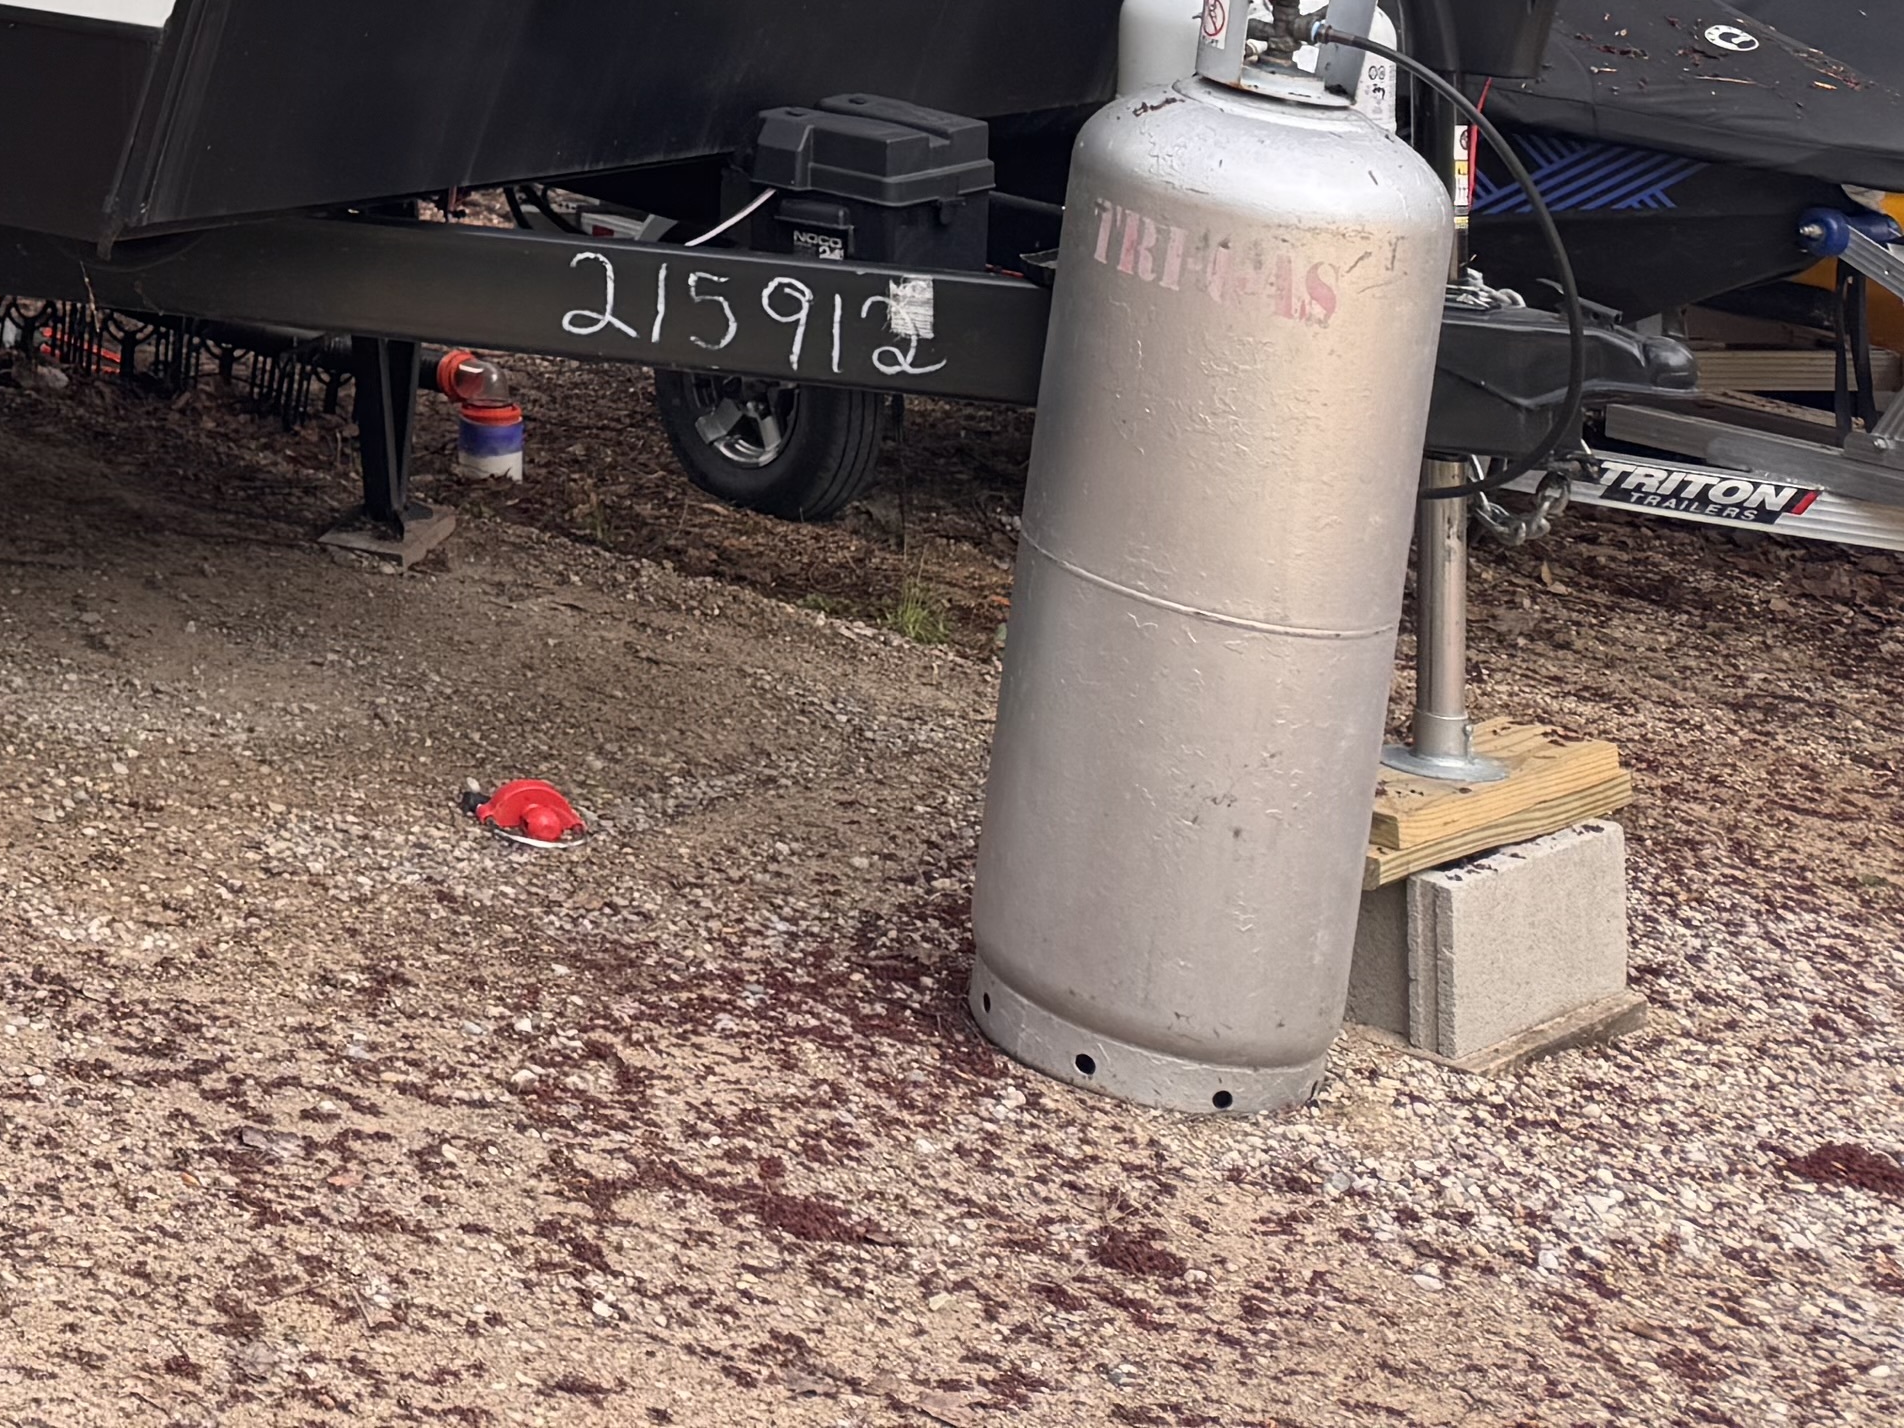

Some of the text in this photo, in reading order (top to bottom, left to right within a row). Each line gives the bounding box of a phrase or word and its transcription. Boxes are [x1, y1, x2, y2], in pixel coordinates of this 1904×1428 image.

[793, 230, 842, 248] NOCO
[1600, 461, 1797, 511] TRITON
[1630, 492, 1758, 521] TRAILERS
